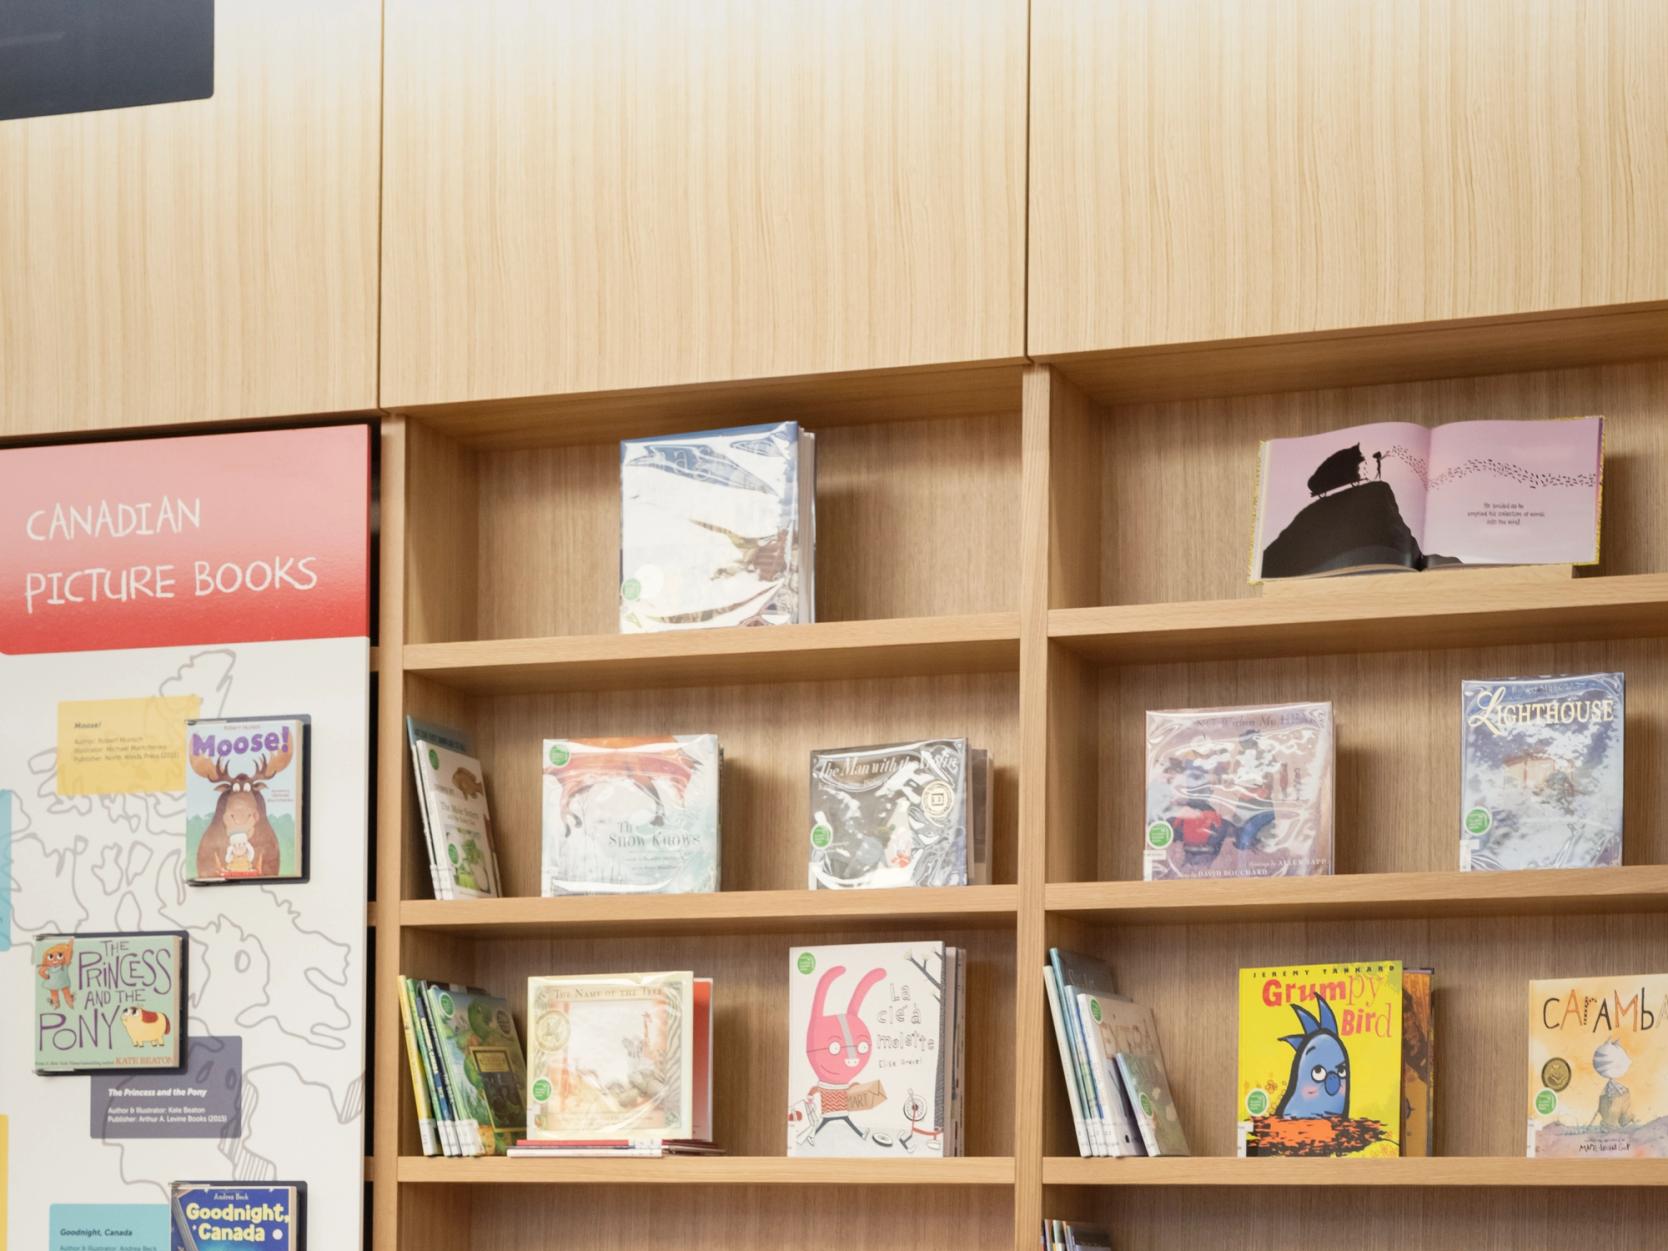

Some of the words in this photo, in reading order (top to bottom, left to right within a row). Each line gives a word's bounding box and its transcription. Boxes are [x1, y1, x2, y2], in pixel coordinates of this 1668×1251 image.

[26, 496, 200, 540] CANADIAN
[25, 564, 175, 615] PICTURE
[194, 555, 318, 597] BOOKS
[192, 725, 290, 757] Moose!
[840, 756, 870, 776] Man
[872, 757, 897, 773] with
[101, 940, 130, 957] THE
[1253, 969, 1309, 978] JEREMY
[1322, 965, 1395, 975] TANKARD
[84, 990, 111, 1010] AND
[116, 988, 146, 1004] THE
[1262, 975, 1384, 1007] Grumpy
[1340, 1002, 1392, 1038] Bird
[108, 1088, 122, 1097] The
[123, 1088, 156, 1097] Princess
[157, 1088, 171, 1096] and
[173, 1088, 186, 1096] the
[187, 1088, 207, 1098] Pony
[185, 1202, 290, 1224] Goodnight,
[60, 1228, 102, 1238] Goodnight,
[104, 1228, 133, 1236] Canada
[198, 1222, 265, 1242] Canada
